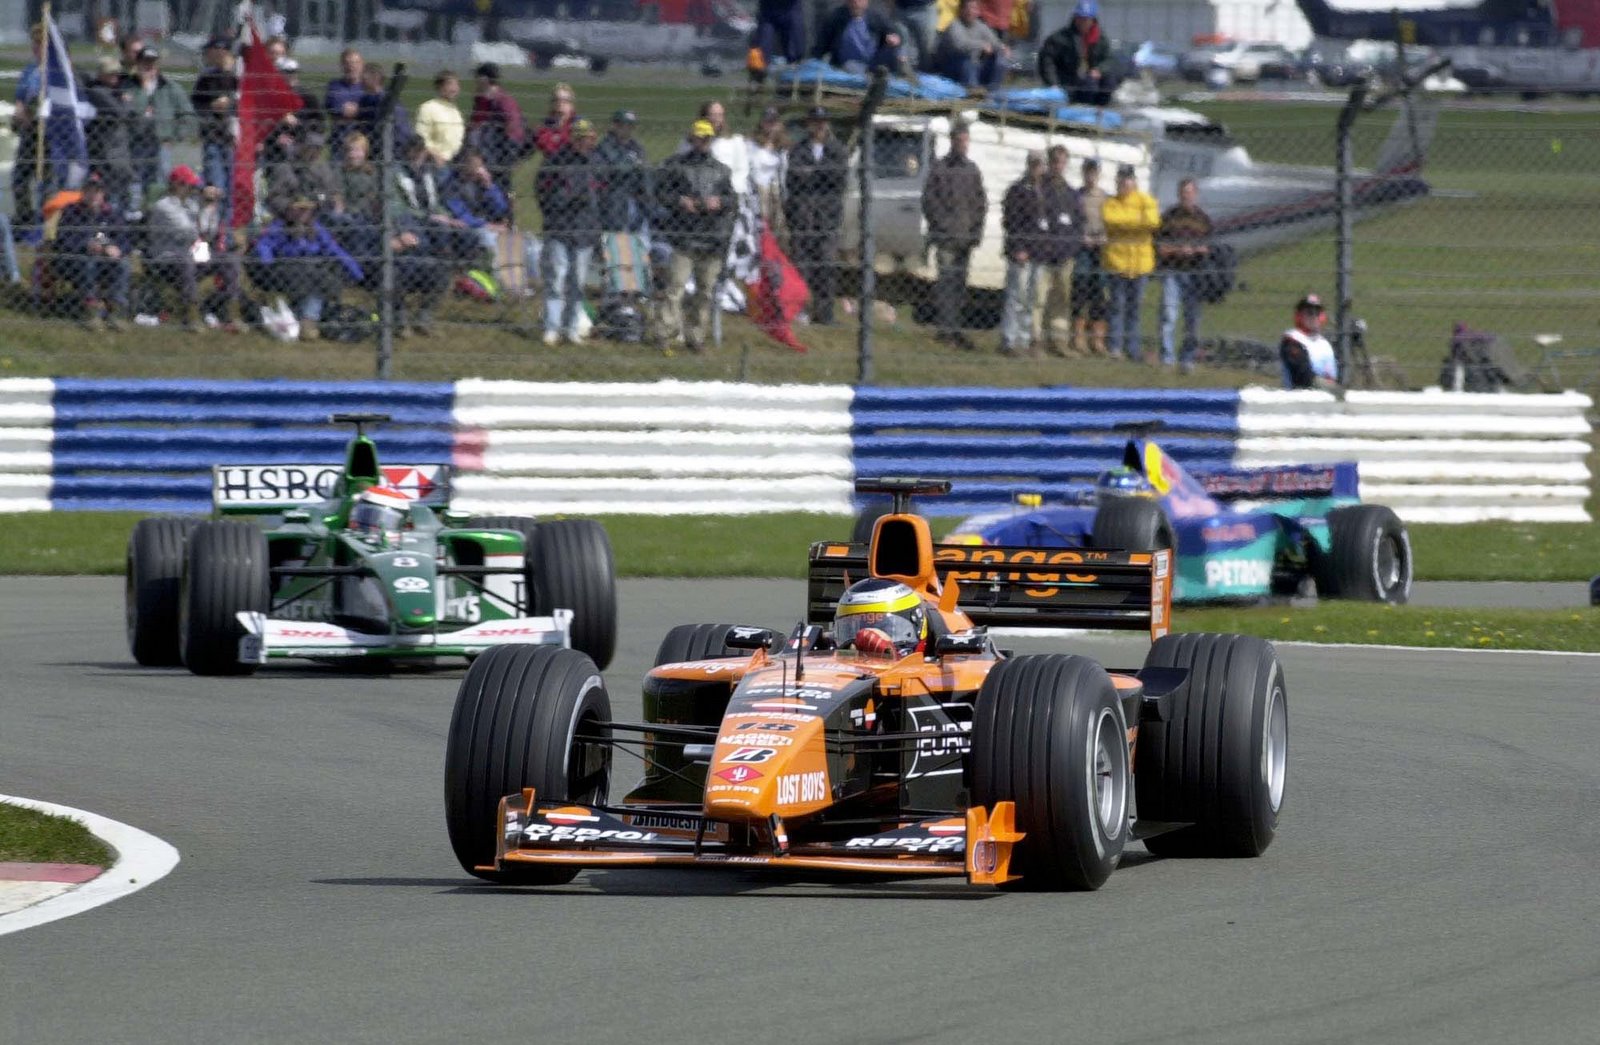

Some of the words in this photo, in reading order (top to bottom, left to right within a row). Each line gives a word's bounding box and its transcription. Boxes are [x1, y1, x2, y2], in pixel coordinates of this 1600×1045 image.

[218, 468, 340, 500] HSBC
[934, 548, 1098, 598] ange
[776, 774, 799, 805] LOST
[801, 771, 825, 802] BOYS
[845, 836, 965, 848] REPSO
